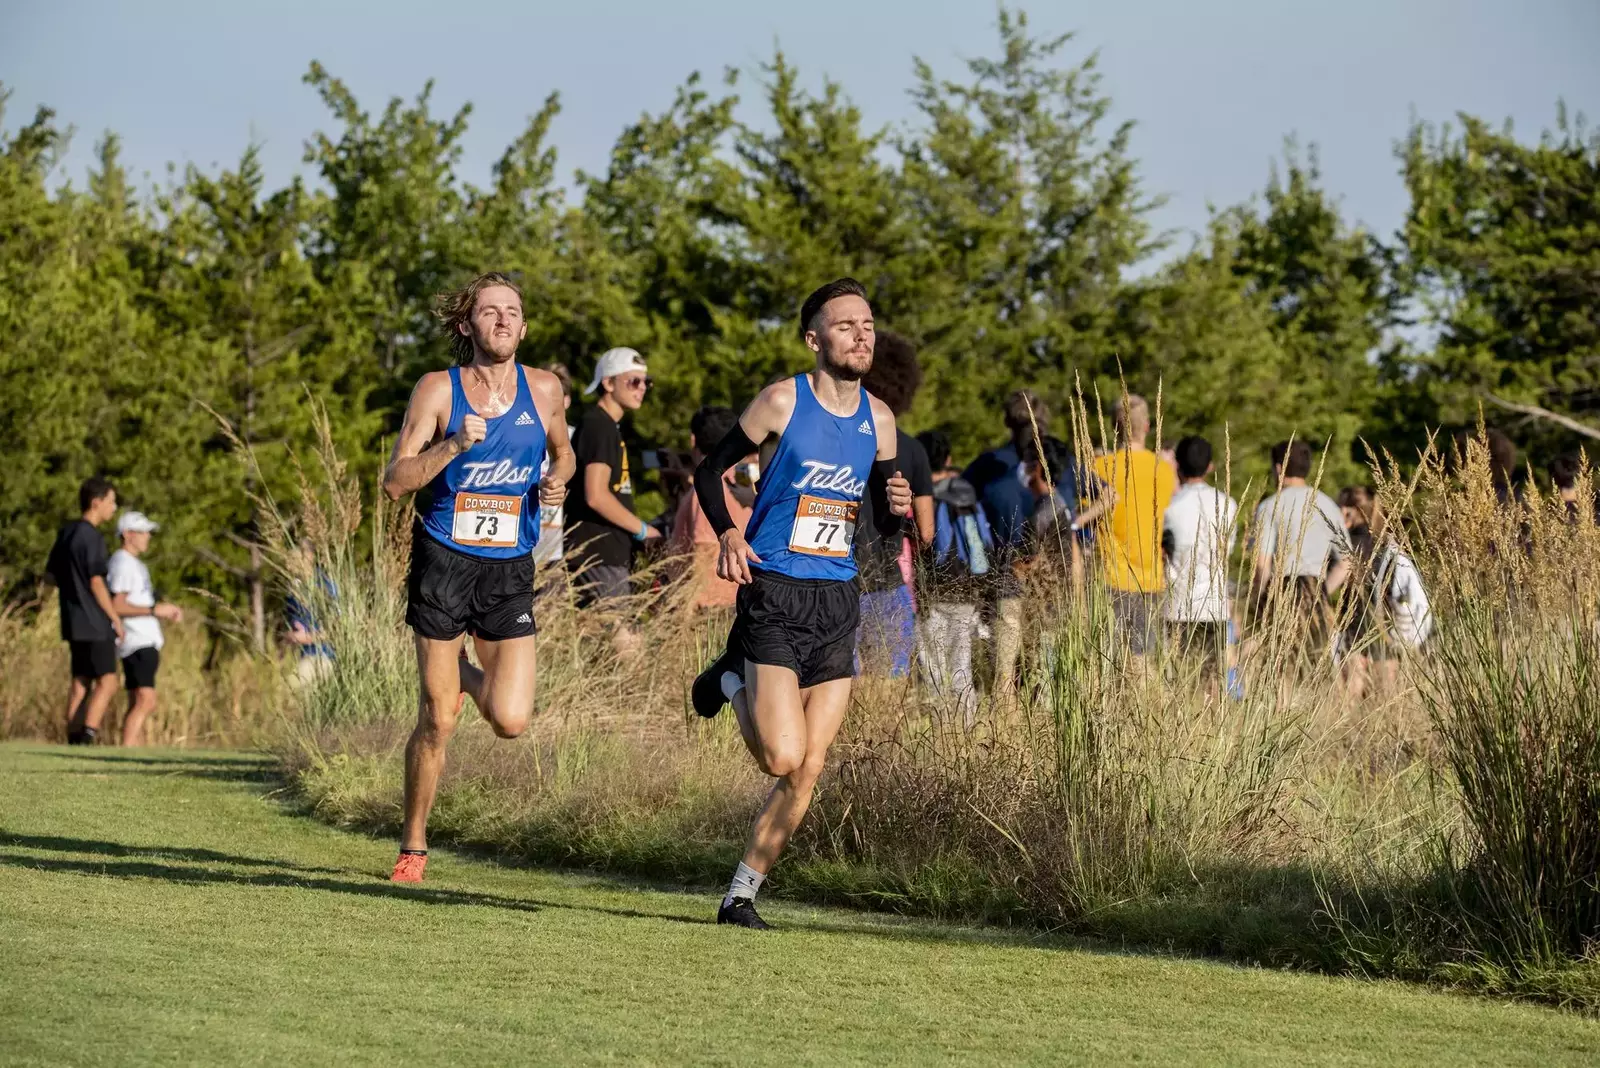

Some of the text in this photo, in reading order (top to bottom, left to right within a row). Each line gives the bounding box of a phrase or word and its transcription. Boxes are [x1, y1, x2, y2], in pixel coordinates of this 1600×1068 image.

[460, 459, 533, 488] Tulsa
[792, 461, 865, 496] Tulsa
[464, 498, 513, 511] COWBOY
[808, 501, 853, 518] COWBOY
[475, 516, 498, 535] 73
[814, 522, 839, 544] 77
